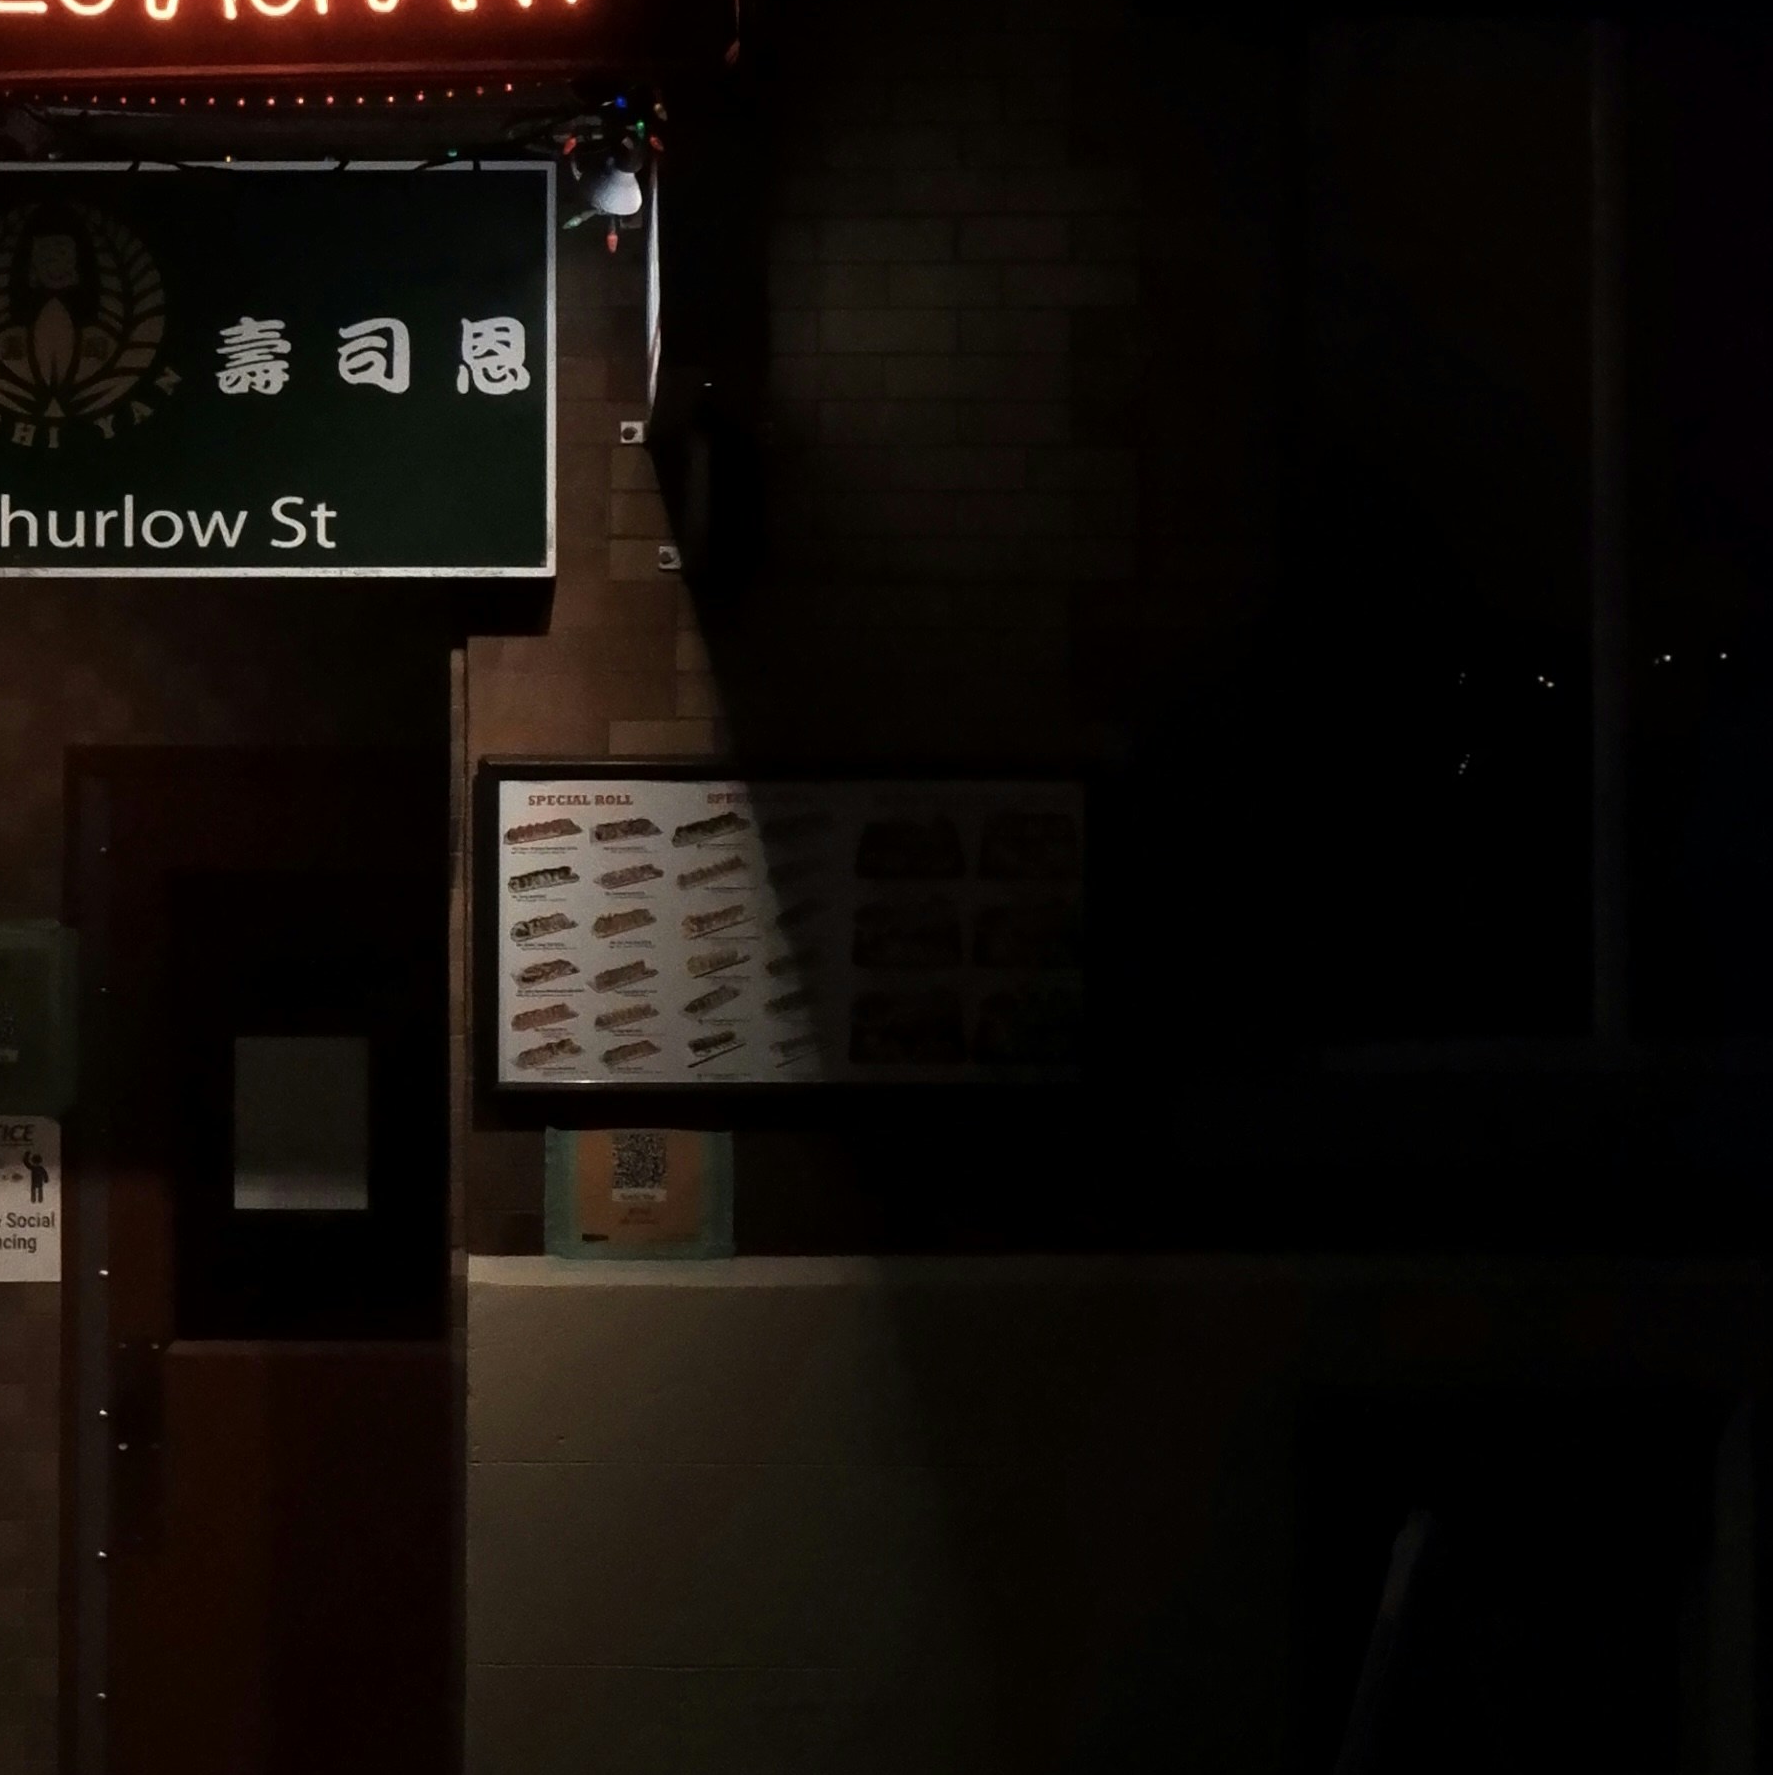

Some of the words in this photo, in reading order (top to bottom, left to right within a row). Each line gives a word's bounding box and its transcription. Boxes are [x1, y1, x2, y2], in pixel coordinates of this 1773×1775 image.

[93, 366, 183, 440] YAN
[269, 496, 338, 549] St
[528, 794, 591, 806] SPECIAL
[594, 794, 634, 806] ROLL
[6, 1211, 55, 1229] Social
